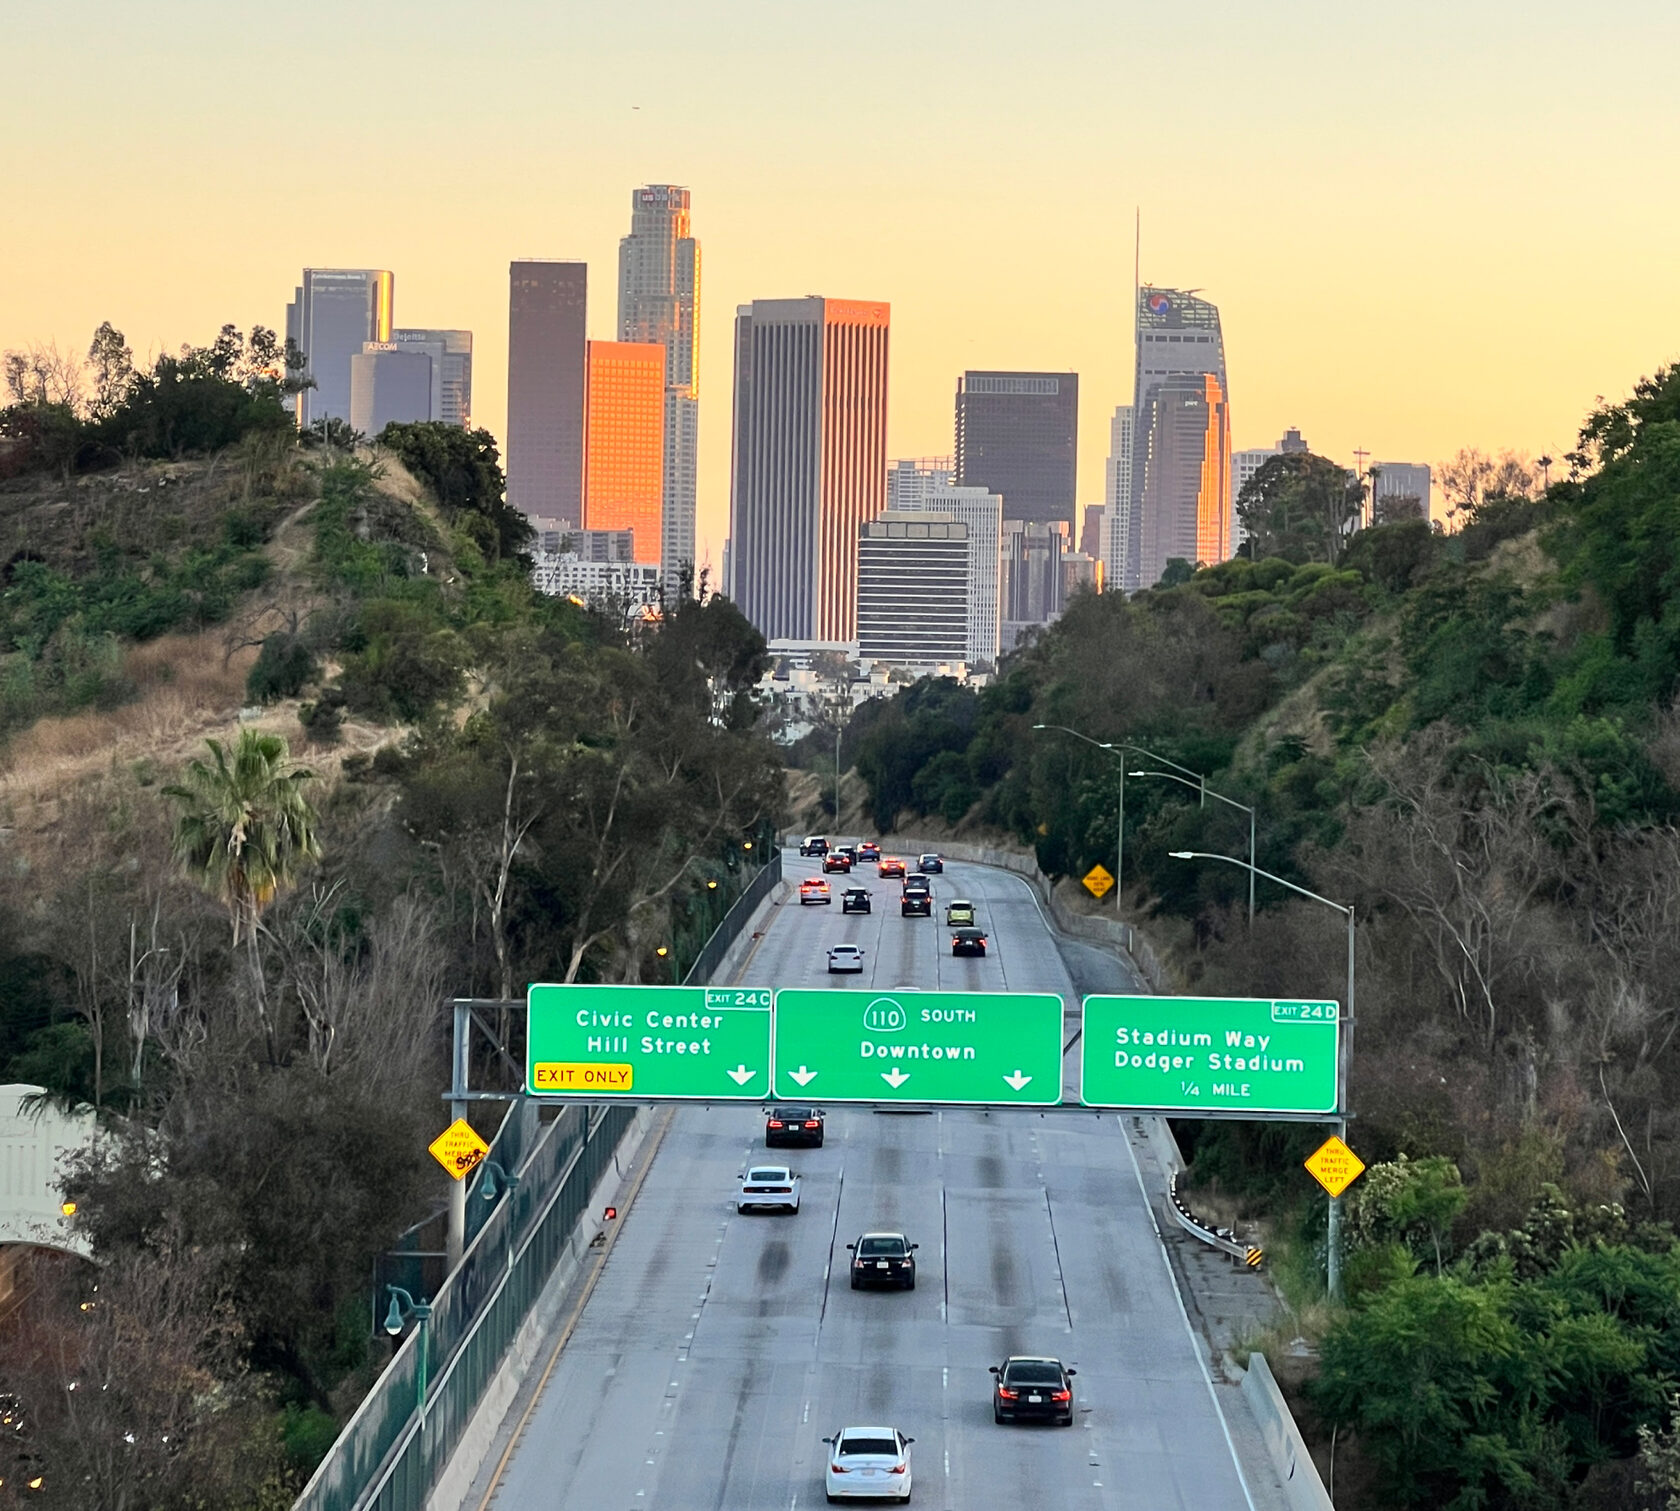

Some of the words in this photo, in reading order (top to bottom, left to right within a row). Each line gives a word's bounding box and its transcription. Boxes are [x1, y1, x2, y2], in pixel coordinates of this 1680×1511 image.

[367, 342, 398, 351] AECOM
[708, 993, 730, 1003] EXIT
[734, 992, 770, 1006] 24C
[576, 1009, 633, 1028] Civic
[646, 1011, 723, 1029] Center
[871, 1010, 900, 1027] 110
[920, 1009, 976, 1023] SOUTH
[1274, 1006, 1297, 1016] EXIT
[1300, 1005, 1336, 1018] 24D
[587, 1036, 628, 1053] Hill
[640, 1036, 711, 1055] Street
[1116, 1027, 1212, 1047] Stadium
[1225, 1030, 1271, 1052] Way
[860, 1041, 976, 1060] Downtown
[1115, 1051, 1194, 1074] Dodger
[1208, 1053, 1304, 1072] Stadium
[537, 1069, 575, 1082] EXIT
[584, 1070, 629, 1084] ONLY
[1212, 1083, 1251, 1097] MILE
